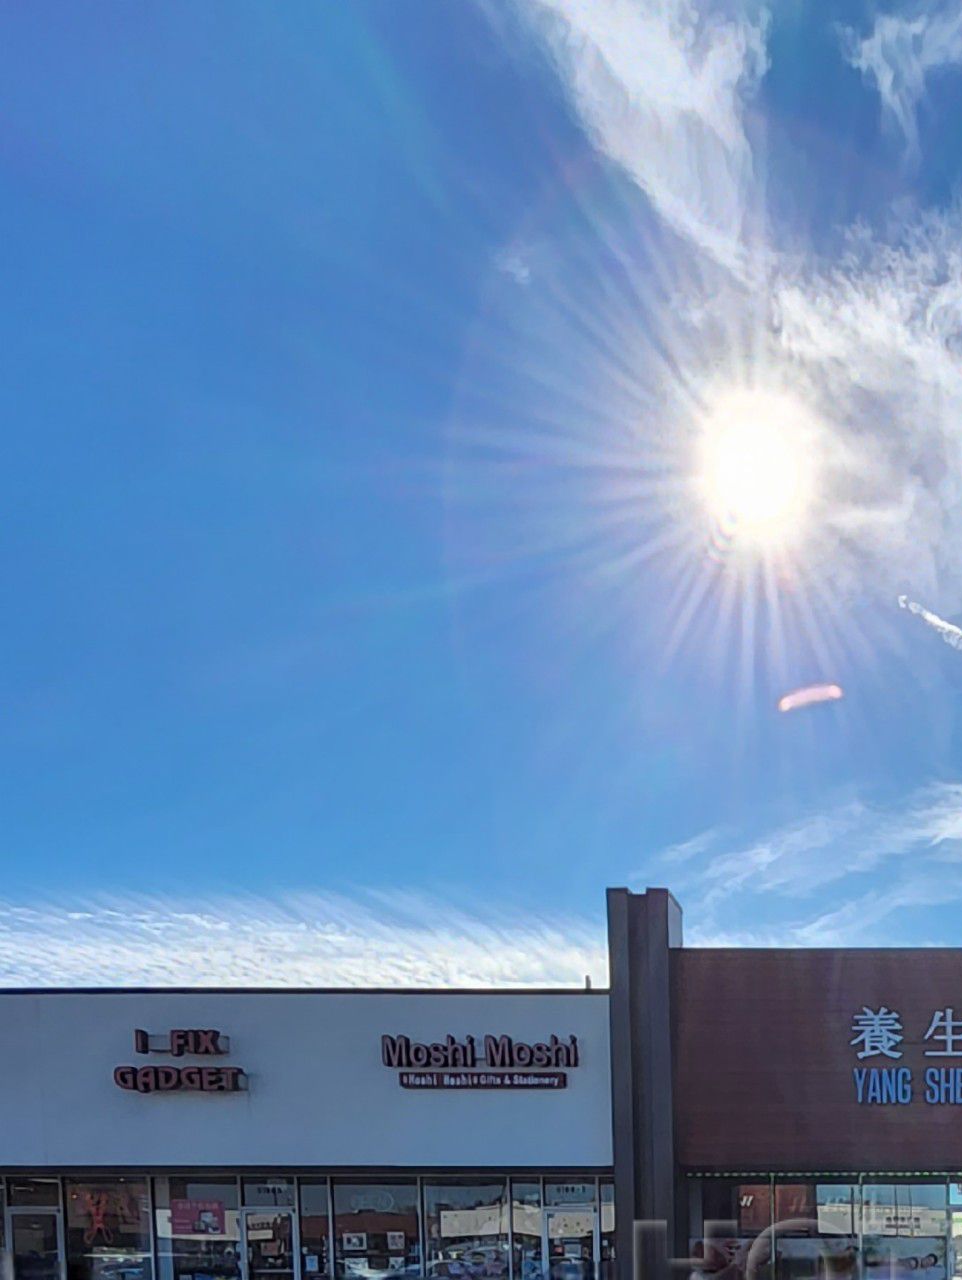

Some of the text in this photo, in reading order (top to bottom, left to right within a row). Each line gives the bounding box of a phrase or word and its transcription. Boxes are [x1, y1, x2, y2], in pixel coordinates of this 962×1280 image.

[135, 1029, 221, 1057] I FIX
[382, 1034, 579, 1067] Moshi Moshi
[114, 1065, 244, 1093] GADGET
[853, 1067, 912, 1104] YANG
